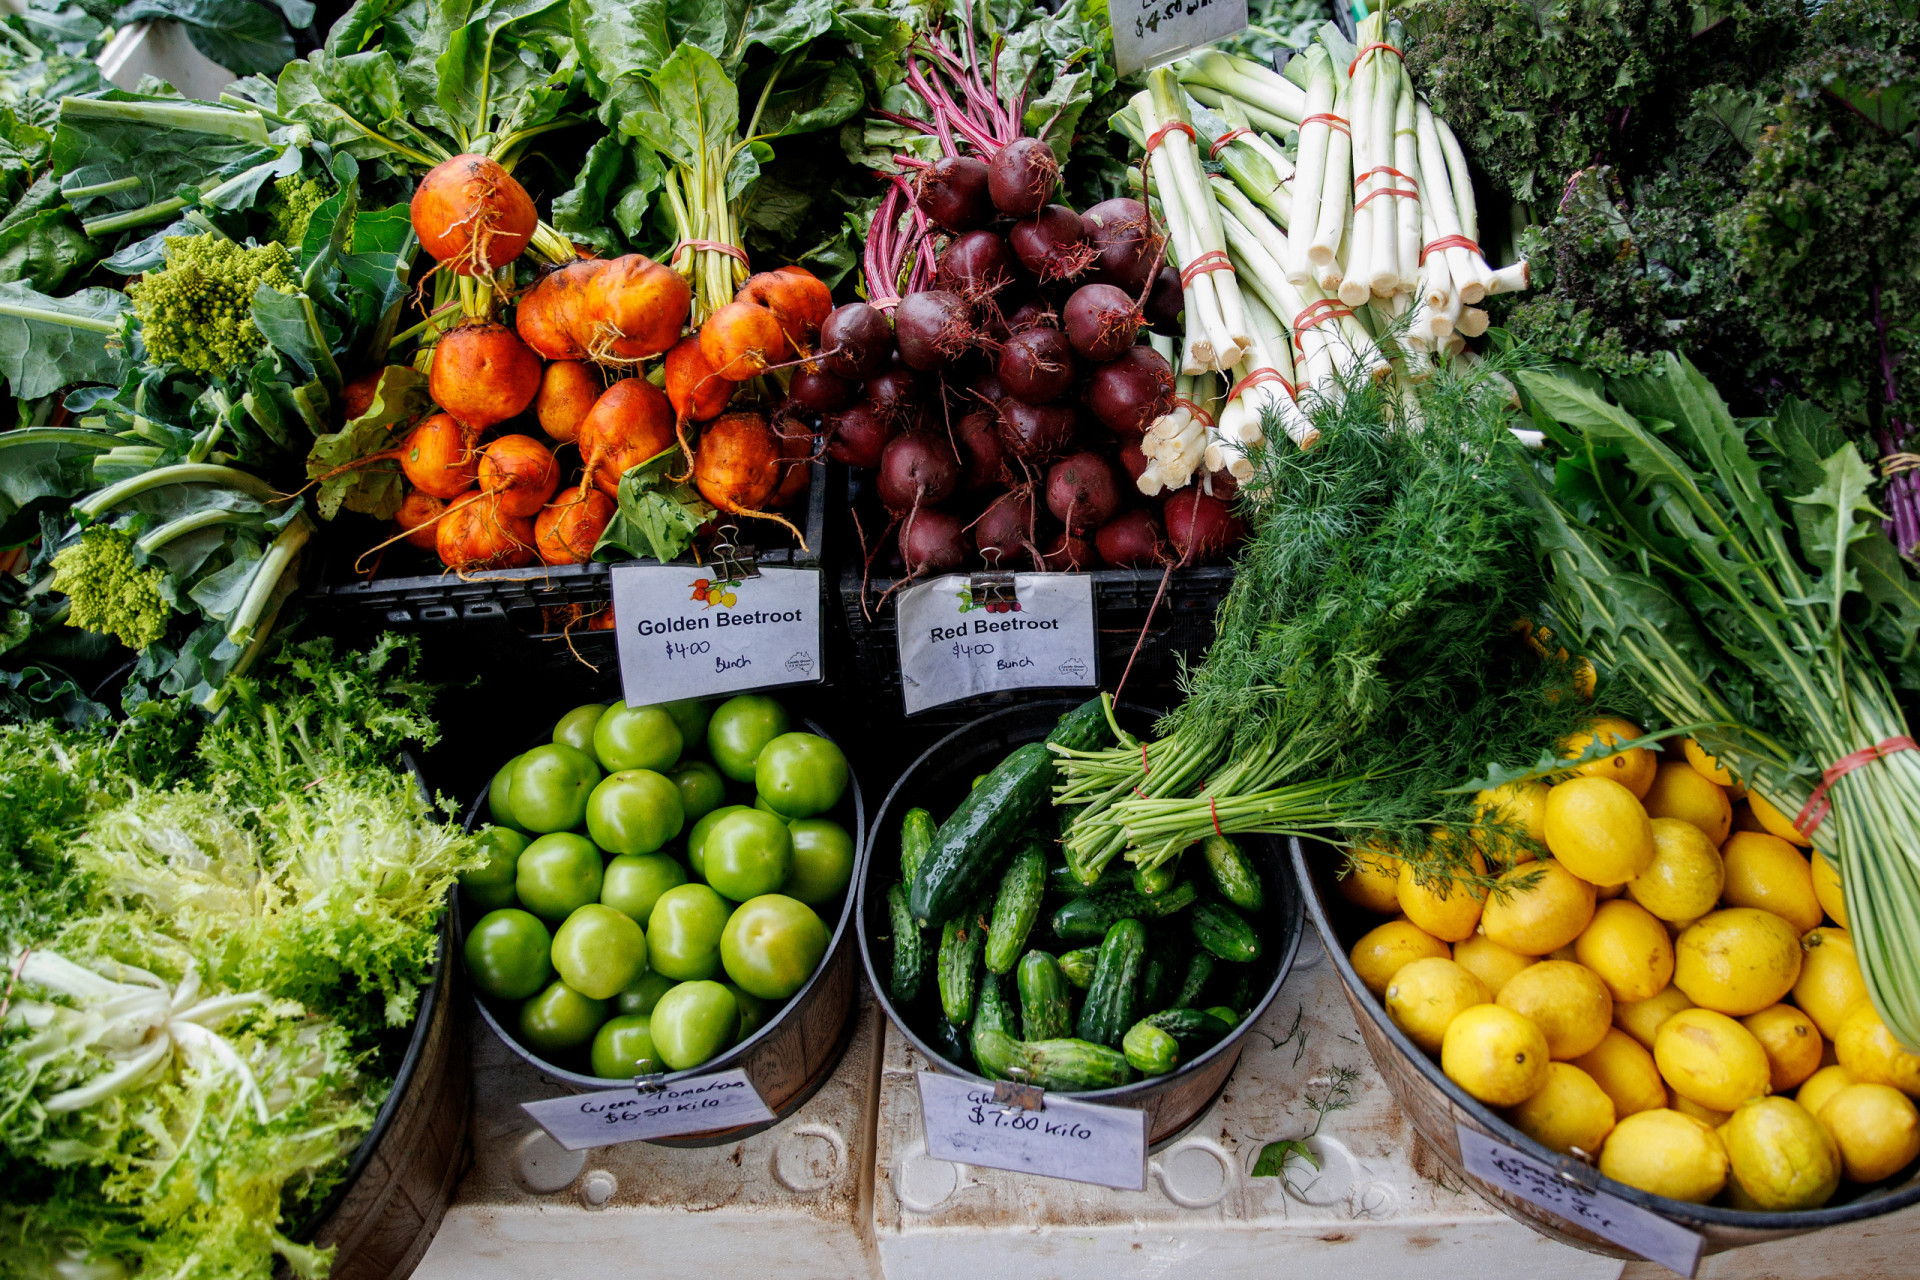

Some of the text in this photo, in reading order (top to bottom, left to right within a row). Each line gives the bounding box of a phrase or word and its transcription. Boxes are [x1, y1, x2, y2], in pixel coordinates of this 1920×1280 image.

[1135, 0, 1183, 38] $4.50
[637, 608, 802, 636] Golden Beetroot
[930, 617, 1059, 644] Red Beetroot
[666, 640, 711, 660] $4.00
[952, 641, 995, 659] $4.00
[715, 654, 752, 674] Bunch
[996, 656, 1035, 671] Bunch
[580, 1100, 638, 1113] Green
[604, 1104, 670, 1124] $6.50
[968, 1105, 1040, 1131] $7.00
